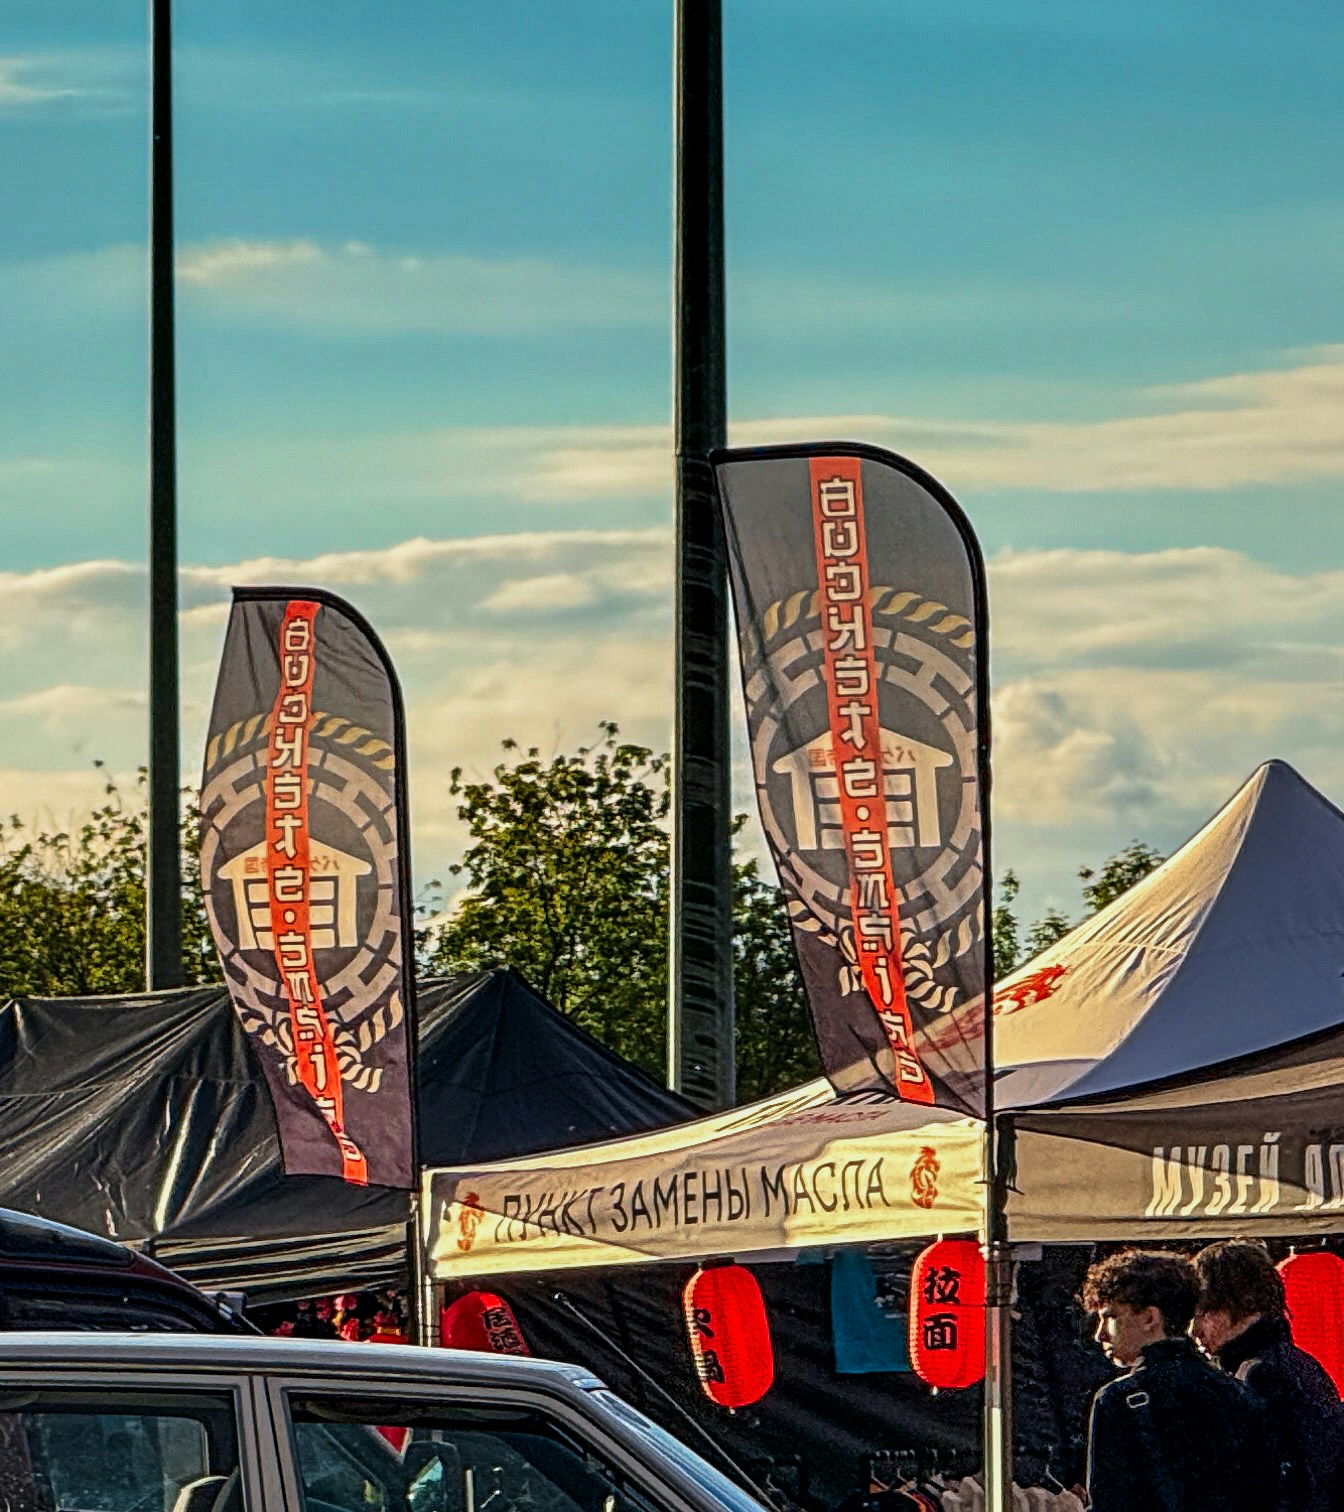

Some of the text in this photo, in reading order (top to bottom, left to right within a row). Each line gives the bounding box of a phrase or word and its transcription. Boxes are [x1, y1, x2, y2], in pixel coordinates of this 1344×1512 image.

[494, 1157, 891, 1243] ПУНКТ ЗАМЕНЫ МАСЛА
[1145, 1132, 1281, 1217] МУЗЕЙ
